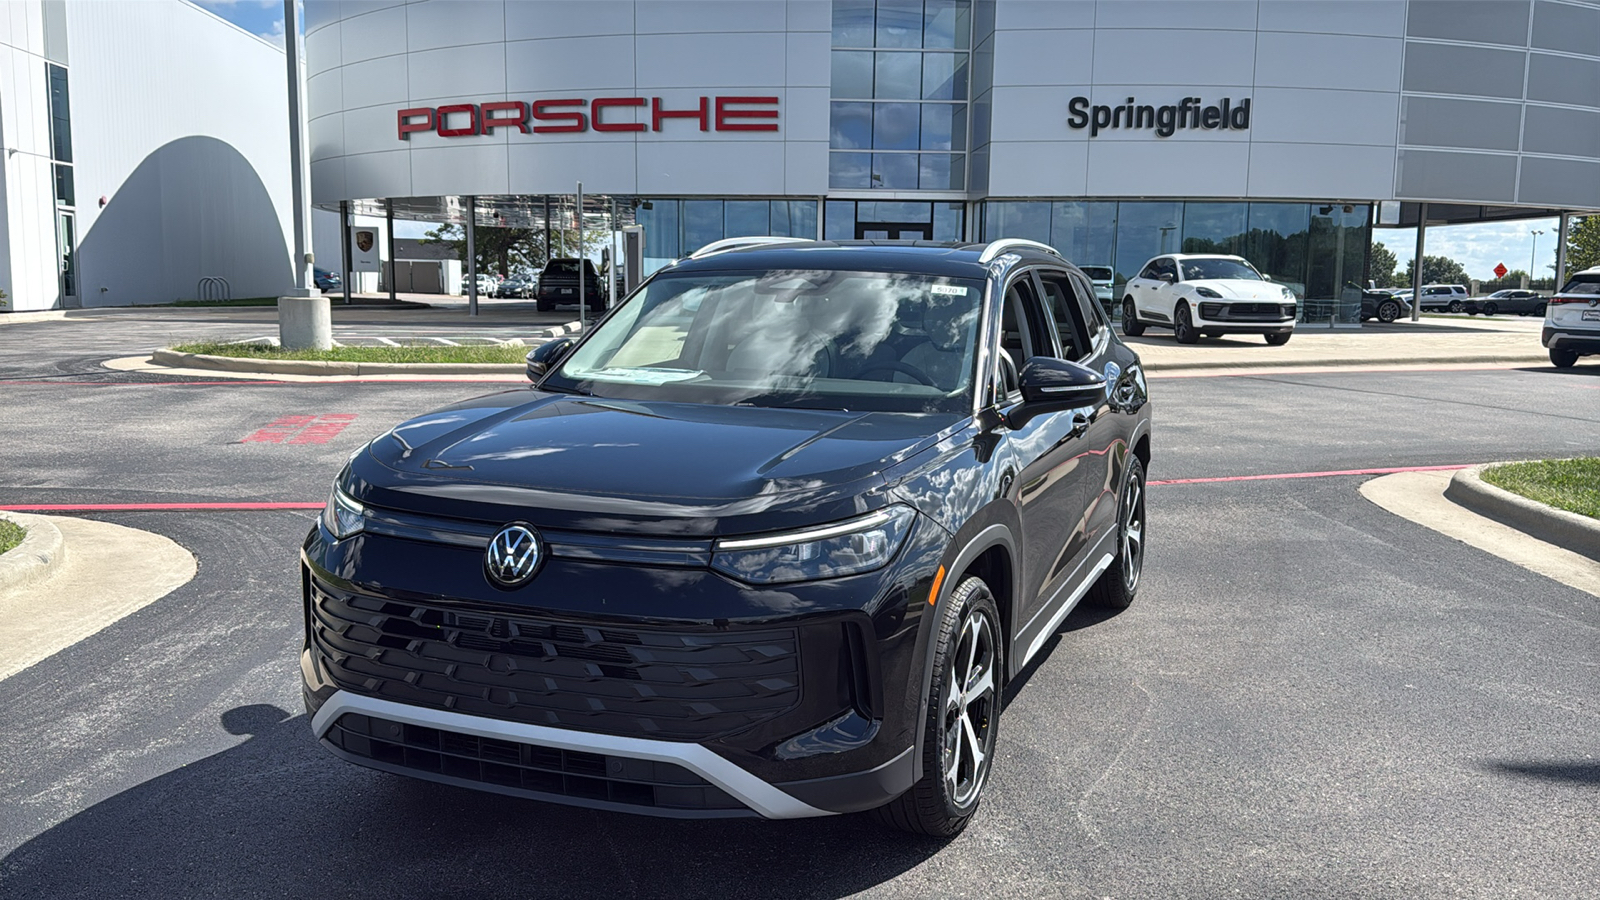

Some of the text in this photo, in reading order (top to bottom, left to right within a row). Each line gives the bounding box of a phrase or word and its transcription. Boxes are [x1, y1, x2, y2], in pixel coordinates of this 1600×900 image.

[397, 96, 779, 141] PORSCHE
[1068, 96, 1251, 137] Springfield
[489, 527, 537, 582] VW
